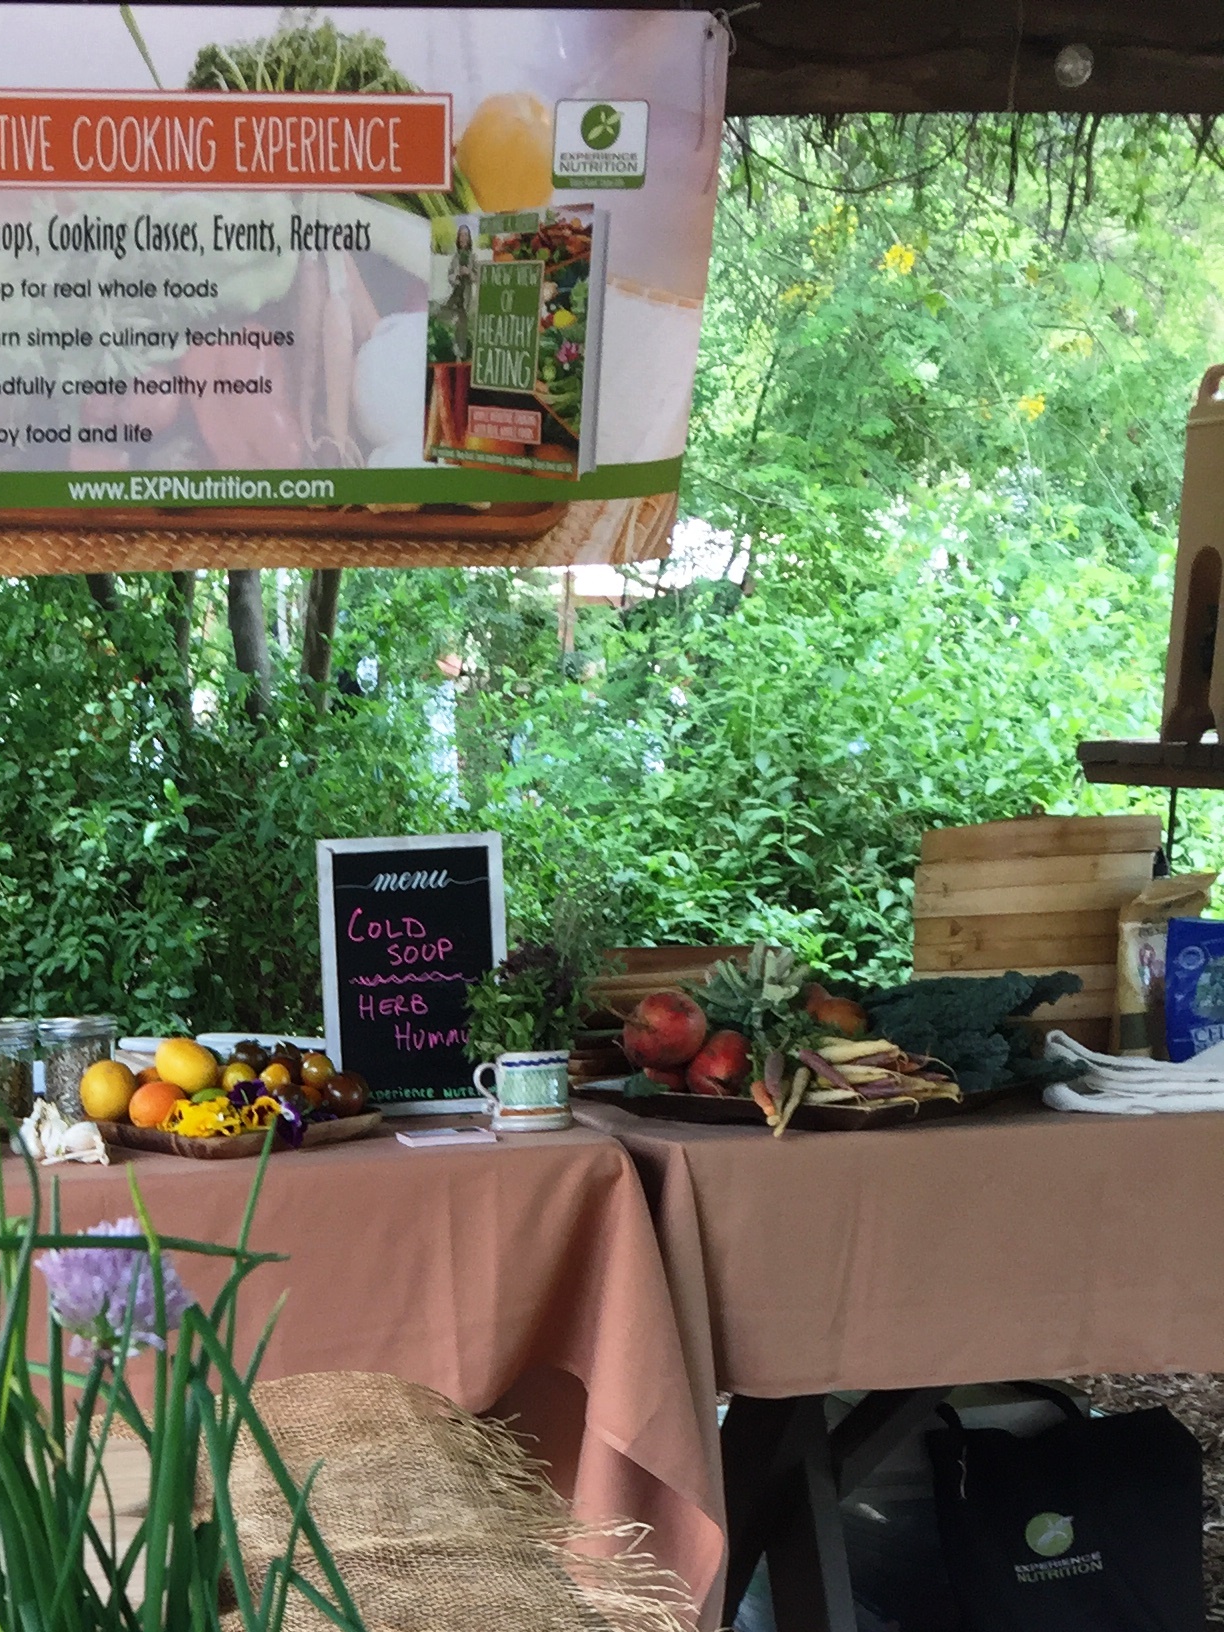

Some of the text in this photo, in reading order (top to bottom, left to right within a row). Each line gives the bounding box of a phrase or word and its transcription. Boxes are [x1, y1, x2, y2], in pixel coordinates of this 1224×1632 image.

[72, 115, 217, 173] COOKING
[234, 116, 403, 174] EXPERIENCE
[559, 151, 638, 160] EXPERIENCE
[559, 160, 639, 173] NUTRITION
[47, 214, 128, 260] Cooking
[134, 214, 205, 257] Classes,
[213, 214, 282, 257] Events,
[290, 214, 372, 253] Retreats
[21, 278, 47, 299] for
[53, 278, 92, 299] real
[97, 279, 158, 299] whole
[163, 278, 219, 299] foods
[26, 327, 94, 350] simple
[98, 327, 179, 350] culinary
[184, 326, 296, 350] techniques
[477, 313, 537, 349] HEALTHY
[475, 346, 533, 389] EATING
[61, 376, 128, 396] create
[133, 375, 208, 398] healthy
[212, 375, 274, 396] meals
[25, 423, 72, 444] food
[77, 424, 118, 444] and
[123, 423, 154, 443] life
[67, 474, 336, 501] www.EXPNutrition.com
[371, 868, 452, 893] menu
[346, 906, 428, 943] COLD
[387, 937, 455, 967] SOUP
[358, 993, 430, 1021] HERB
[394, 1020, 472, 1051] HUMMU
[1013, 1550, 1102, 1573] EXPERIENCE
[1017, 1560, 1104, 1583] NUTRITION
